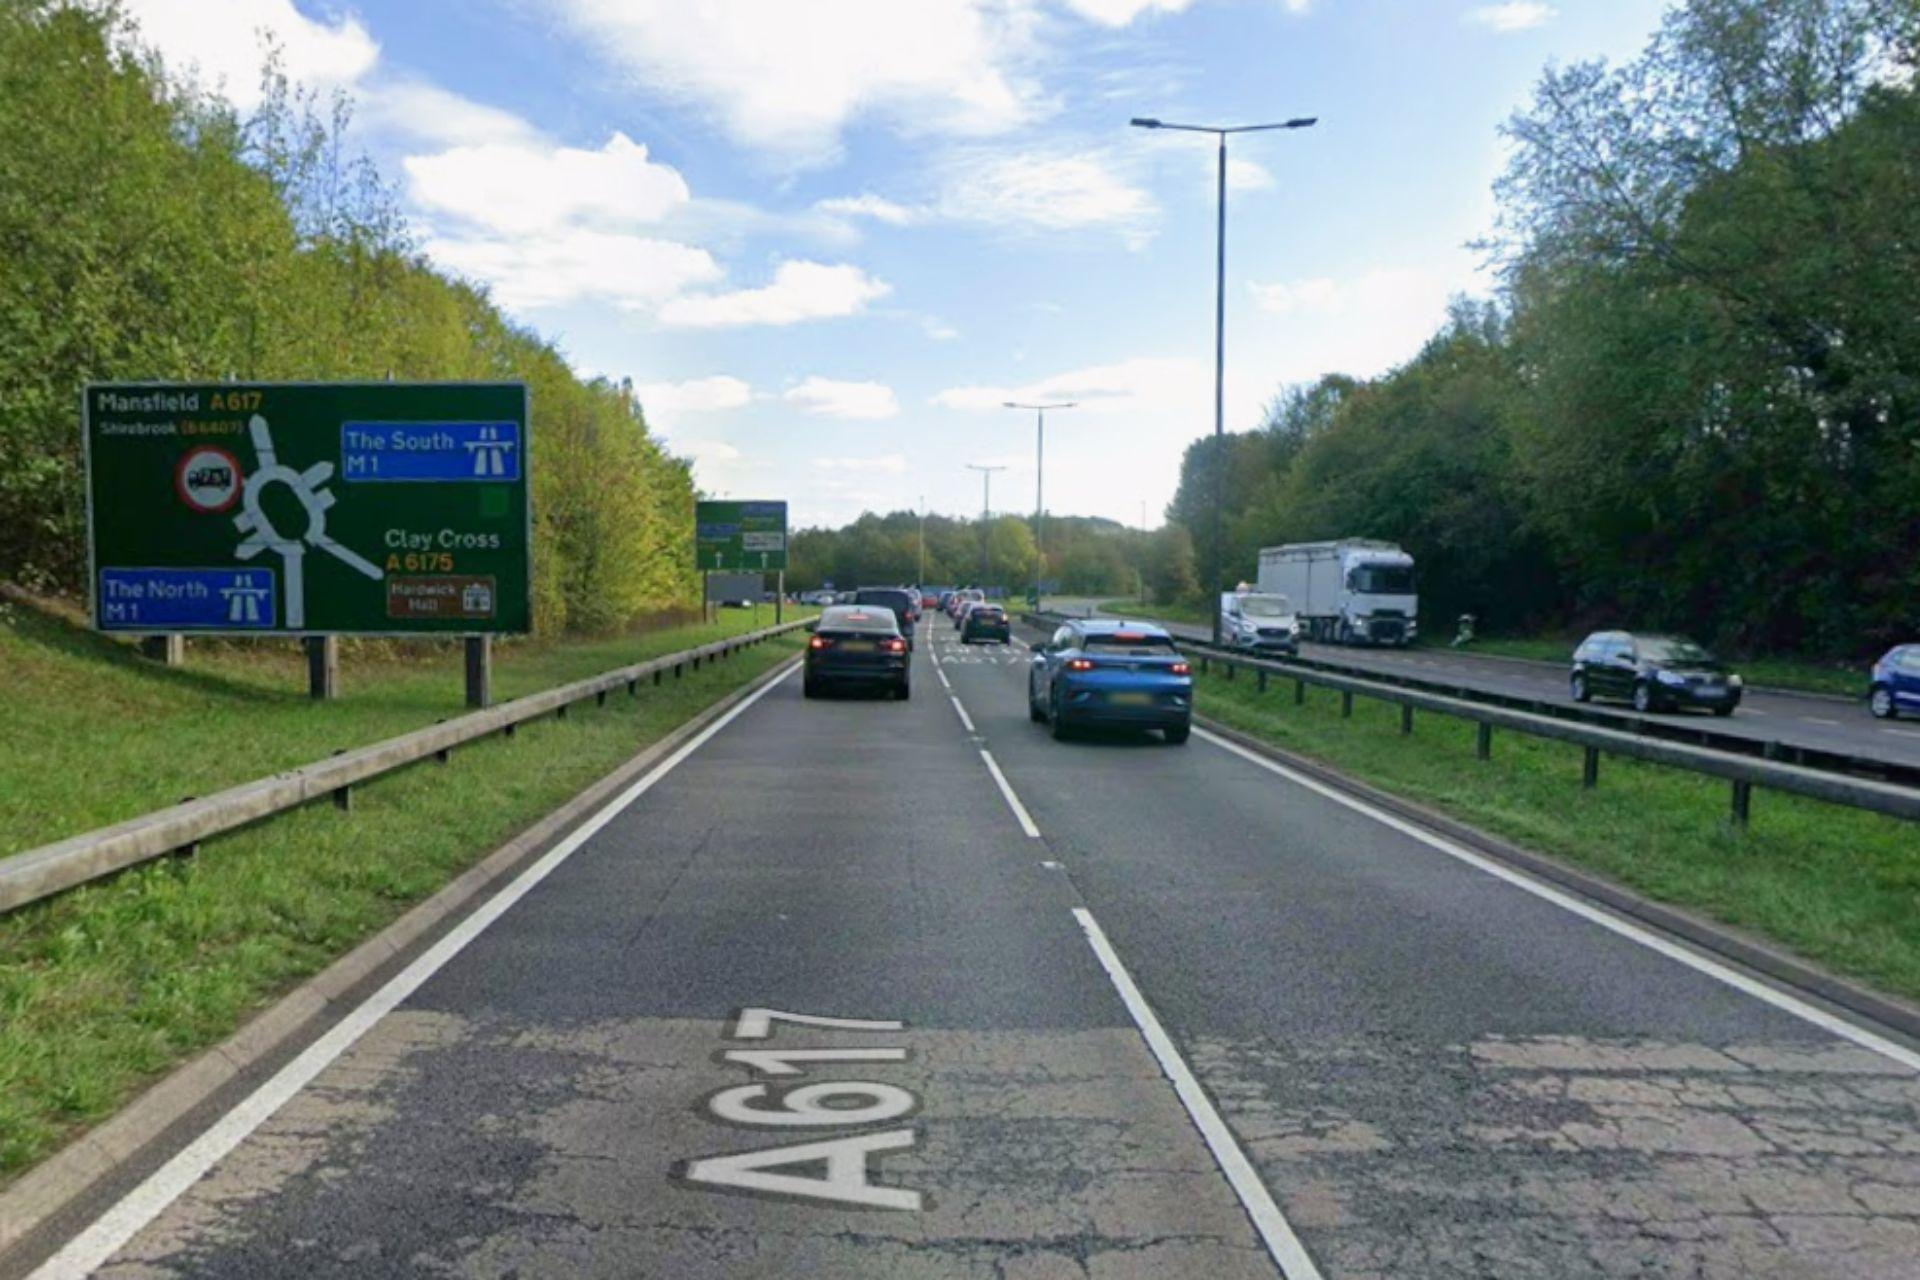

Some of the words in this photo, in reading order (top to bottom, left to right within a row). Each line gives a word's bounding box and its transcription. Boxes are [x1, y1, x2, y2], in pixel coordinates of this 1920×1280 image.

[97, 391, 200, 412] Mansfield
[347, 431, 385, 449] The
[392, 431, 454, 450] South
[384, 528, 432, 551] Clay
[437, 528, 501, 549] Cross
[106, 579, 144, 598] The
[149, 580, 208, 598] North
[686, 1007, 921, 1210] A617
